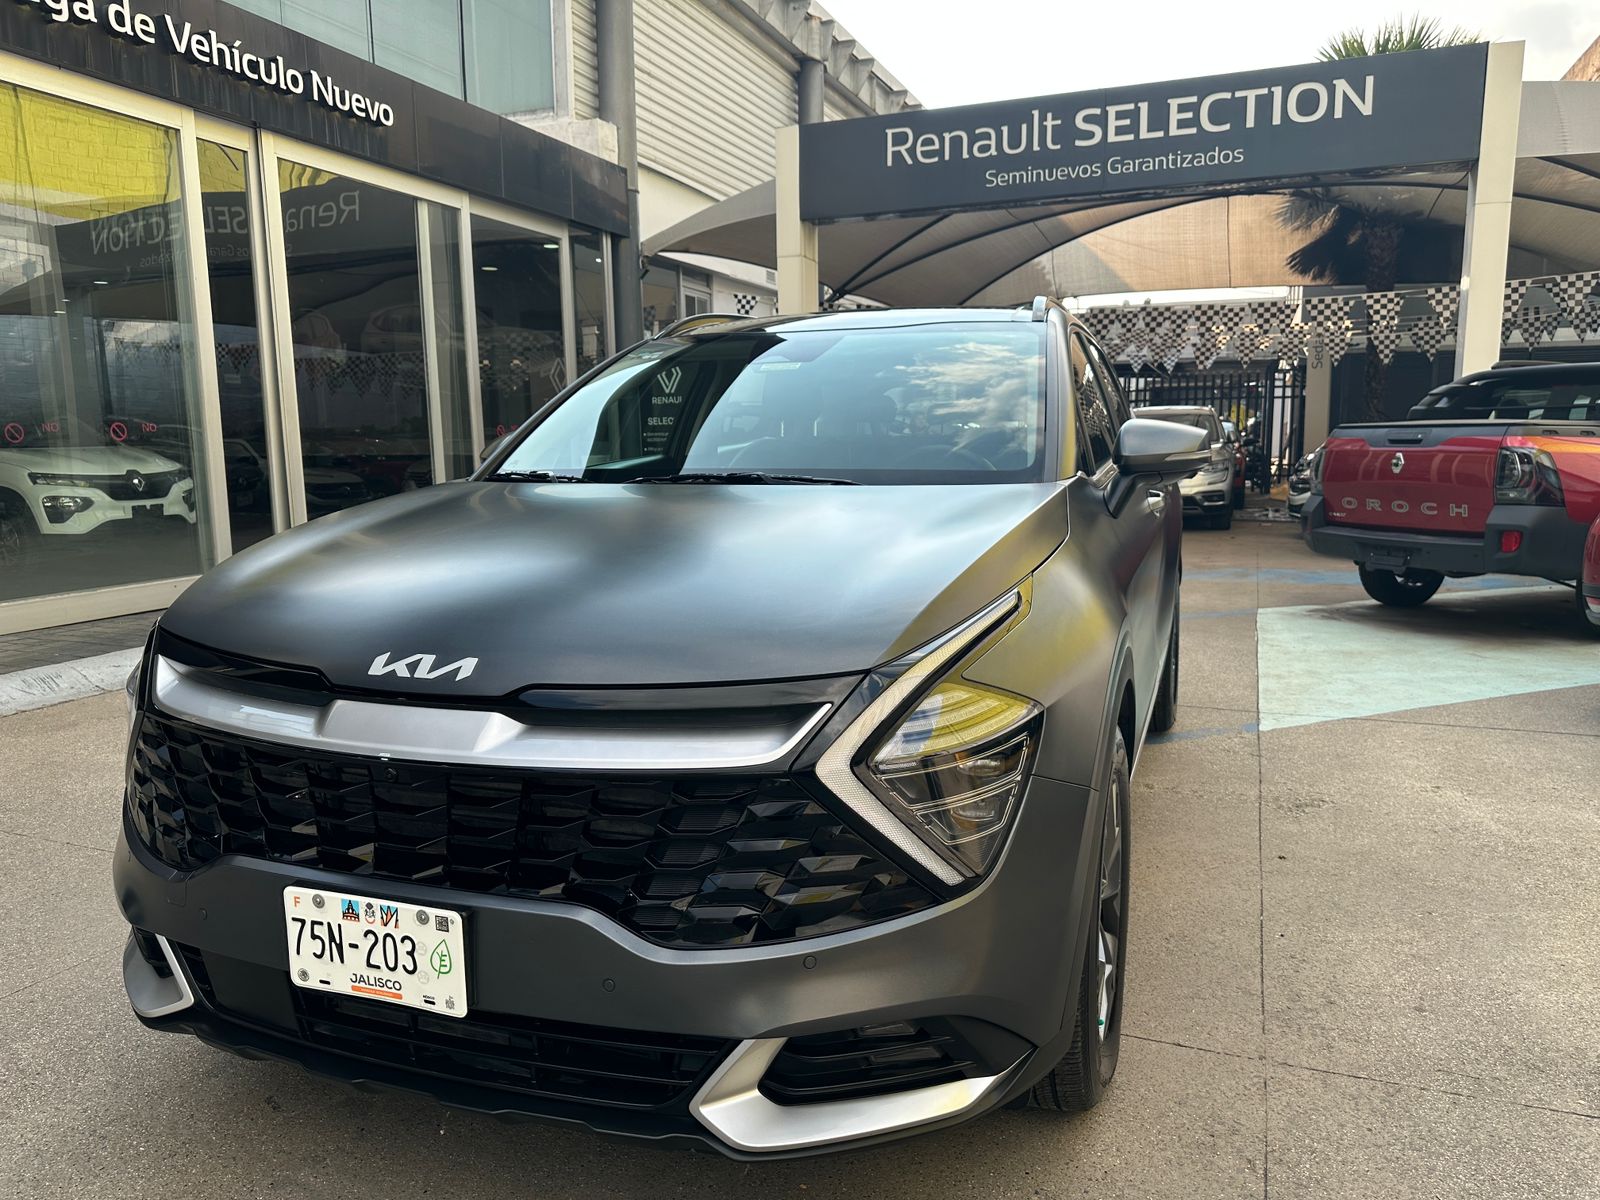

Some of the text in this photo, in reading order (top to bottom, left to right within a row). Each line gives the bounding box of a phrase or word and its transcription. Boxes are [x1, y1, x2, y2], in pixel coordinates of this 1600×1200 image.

[31, 0, 394, 127] ga de Vehículo Nuevo
[886, 75, 1375, 167] Renault SELECTION
[985, 146, 1244, 188] Seminuevos Garantizados
[42, 423, 60, 433] NO
[142, 423, 157, 433] NO
[1341, 497, 1469, 518] OROCH
[367, 651, 479, 682] KIA
[293, 896, 301, 908] F
[291, 917, 418, 975] 75N-203
[350, 973, 402, 991] JALISCO
